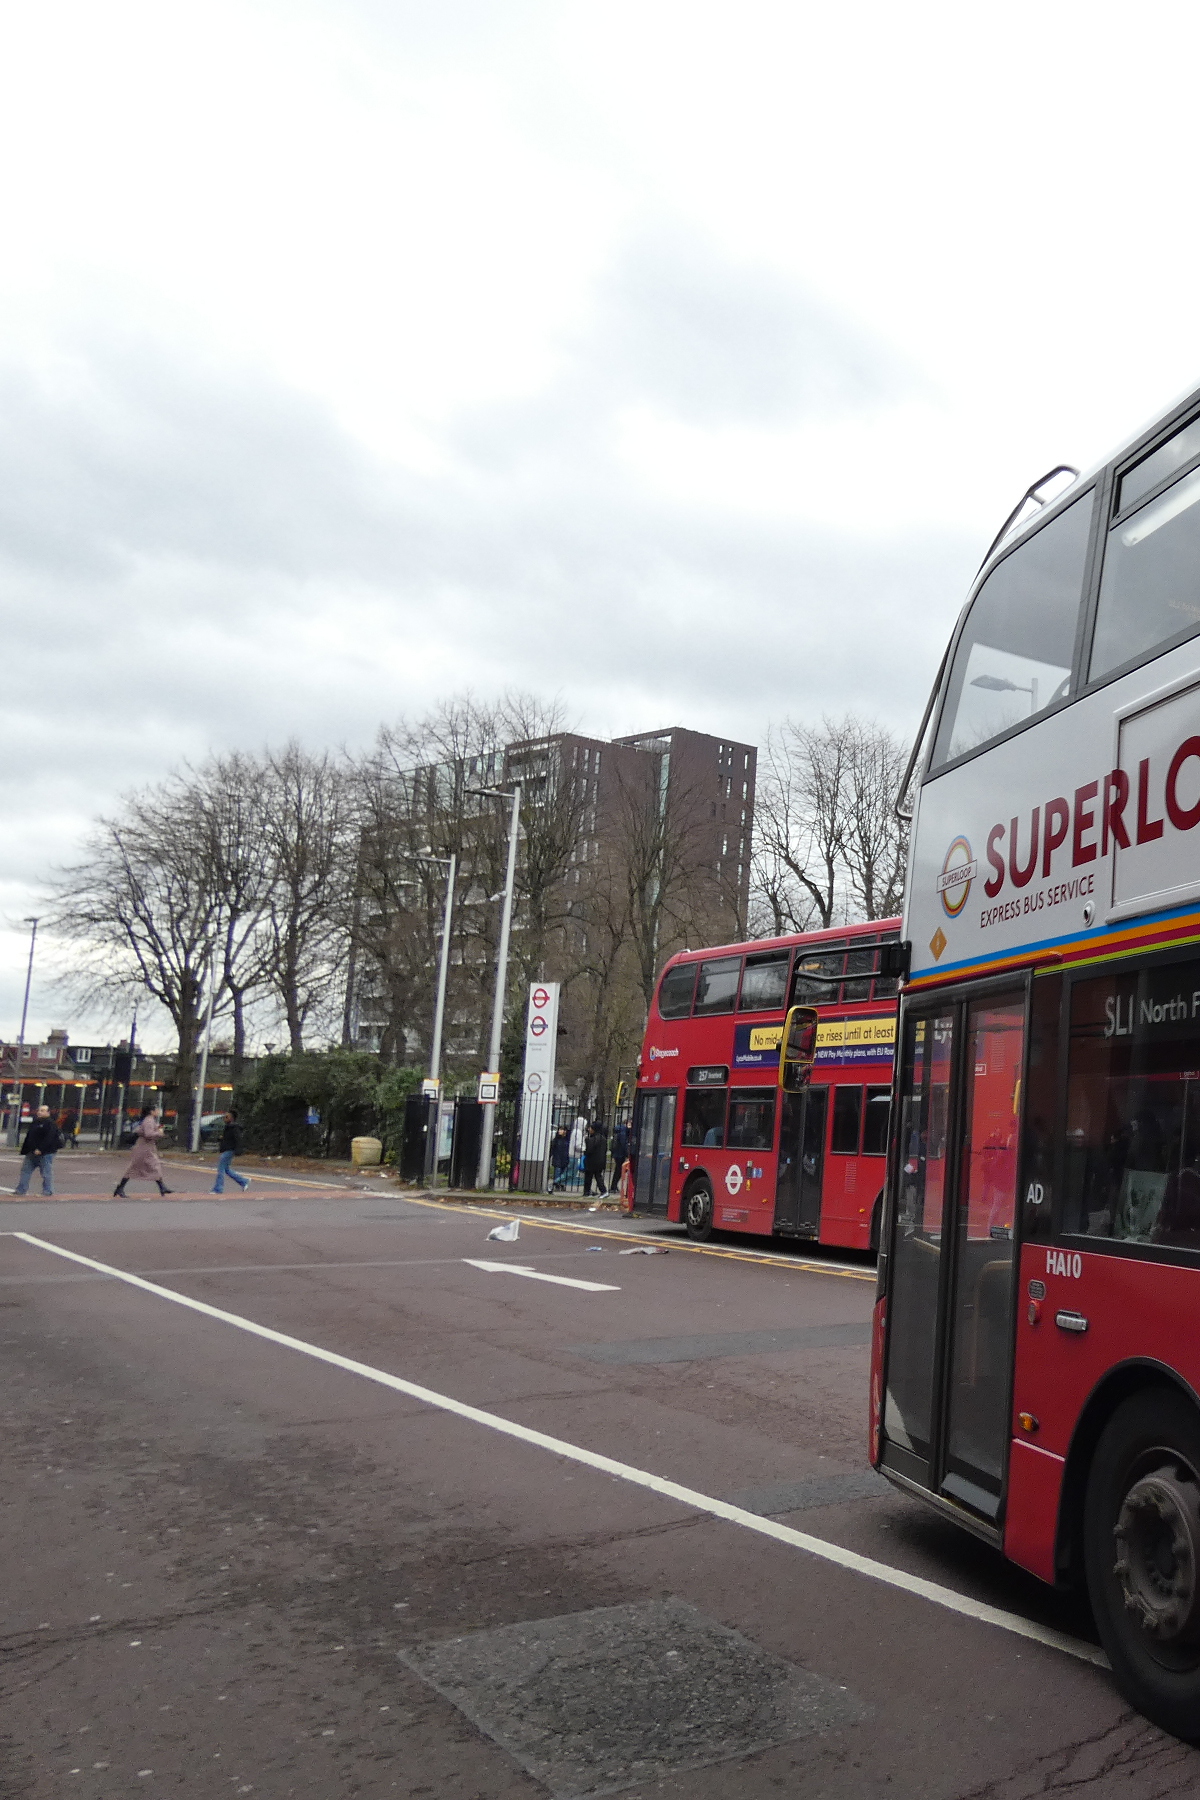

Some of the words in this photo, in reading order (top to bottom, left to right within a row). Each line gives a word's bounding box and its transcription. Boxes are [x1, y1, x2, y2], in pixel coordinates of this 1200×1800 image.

[941, 866, 972, 888] SUPERLOOP
[980, 898, 1021, 928] EXPRESS
[1023, 893, 1045, 916] BUS
[1047, 874, 1094, 906] SERVICE
[1139, 994, 1187, 1024] North
[754, 1035, 763, 1045] No
[826, 1029, 843, 1042] rises
[844, 1027, 862, 1041] until
[863, 1027, 872, 1039] at
[873, 1026, 894, 1039] least
[1026, 1183, 1044, 1205] AD
[1046, 1250, 1082, 1279] HA10
